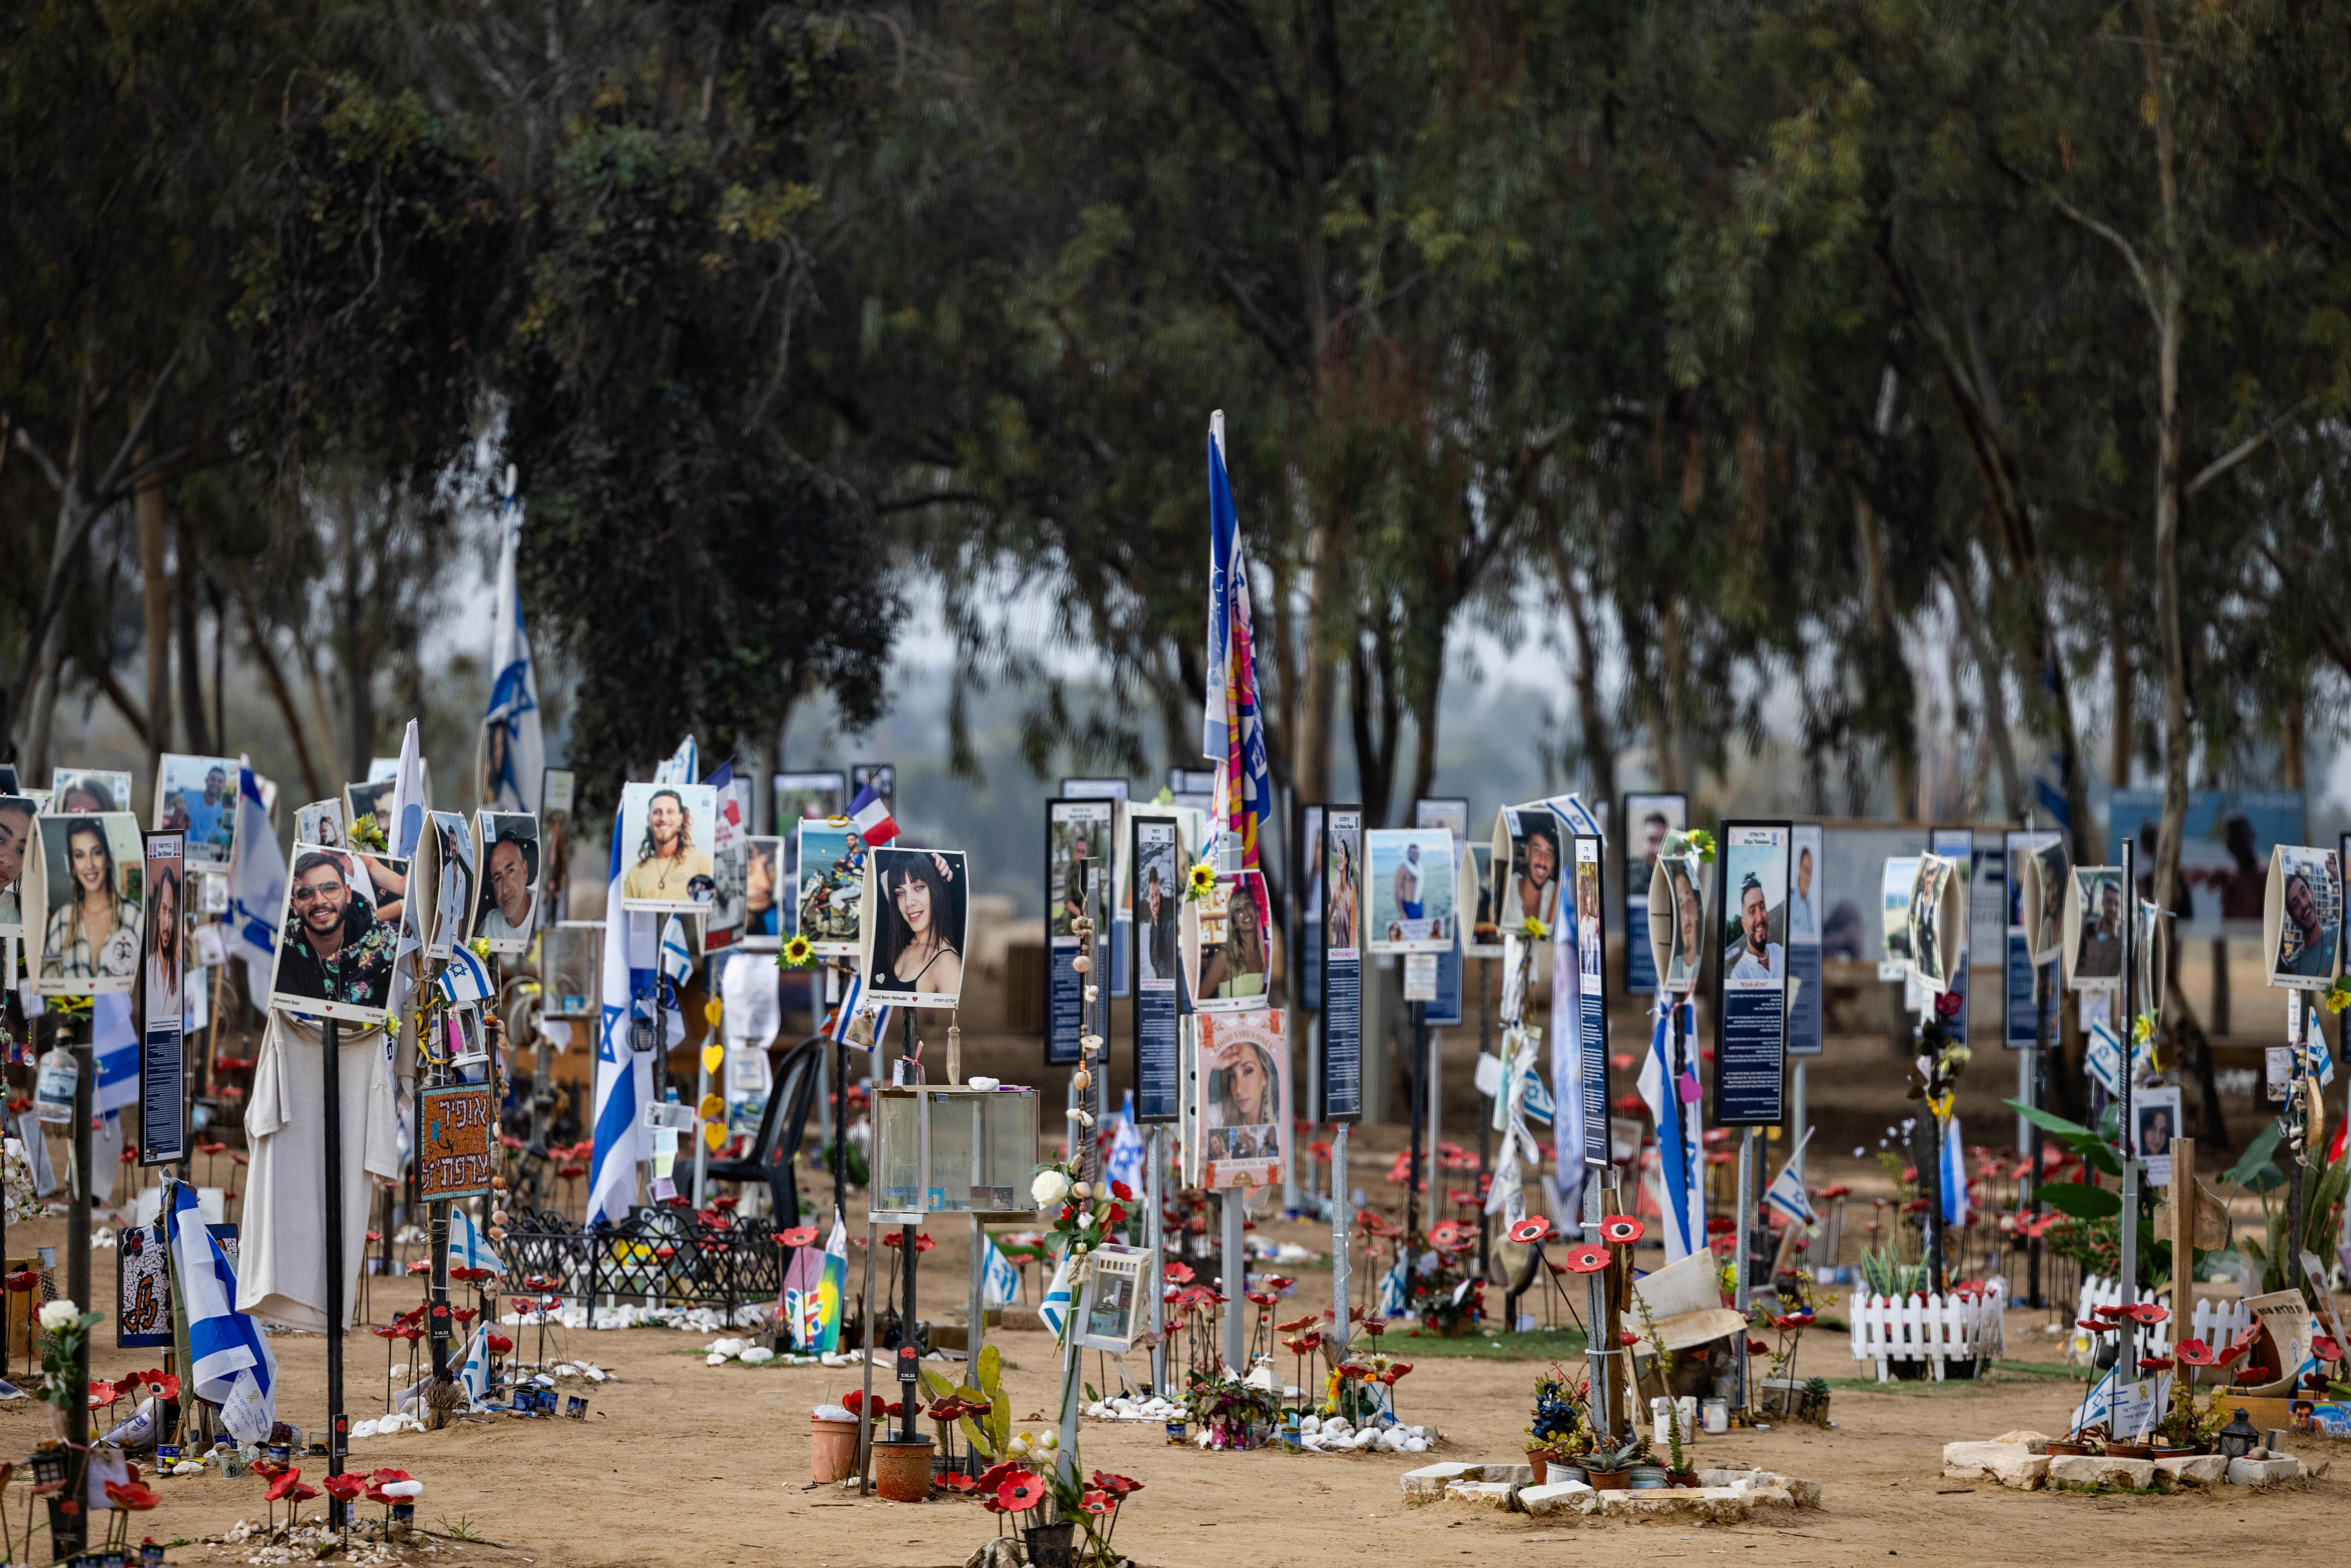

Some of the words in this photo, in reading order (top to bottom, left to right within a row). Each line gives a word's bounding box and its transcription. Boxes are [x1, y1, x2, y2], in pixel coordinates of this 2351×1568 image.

[1257, 1034, 1274, 1049] ONLY
[439, 1096, 487, 1129] אופיר
[437, 1153, 489, 1187] צרפתי
